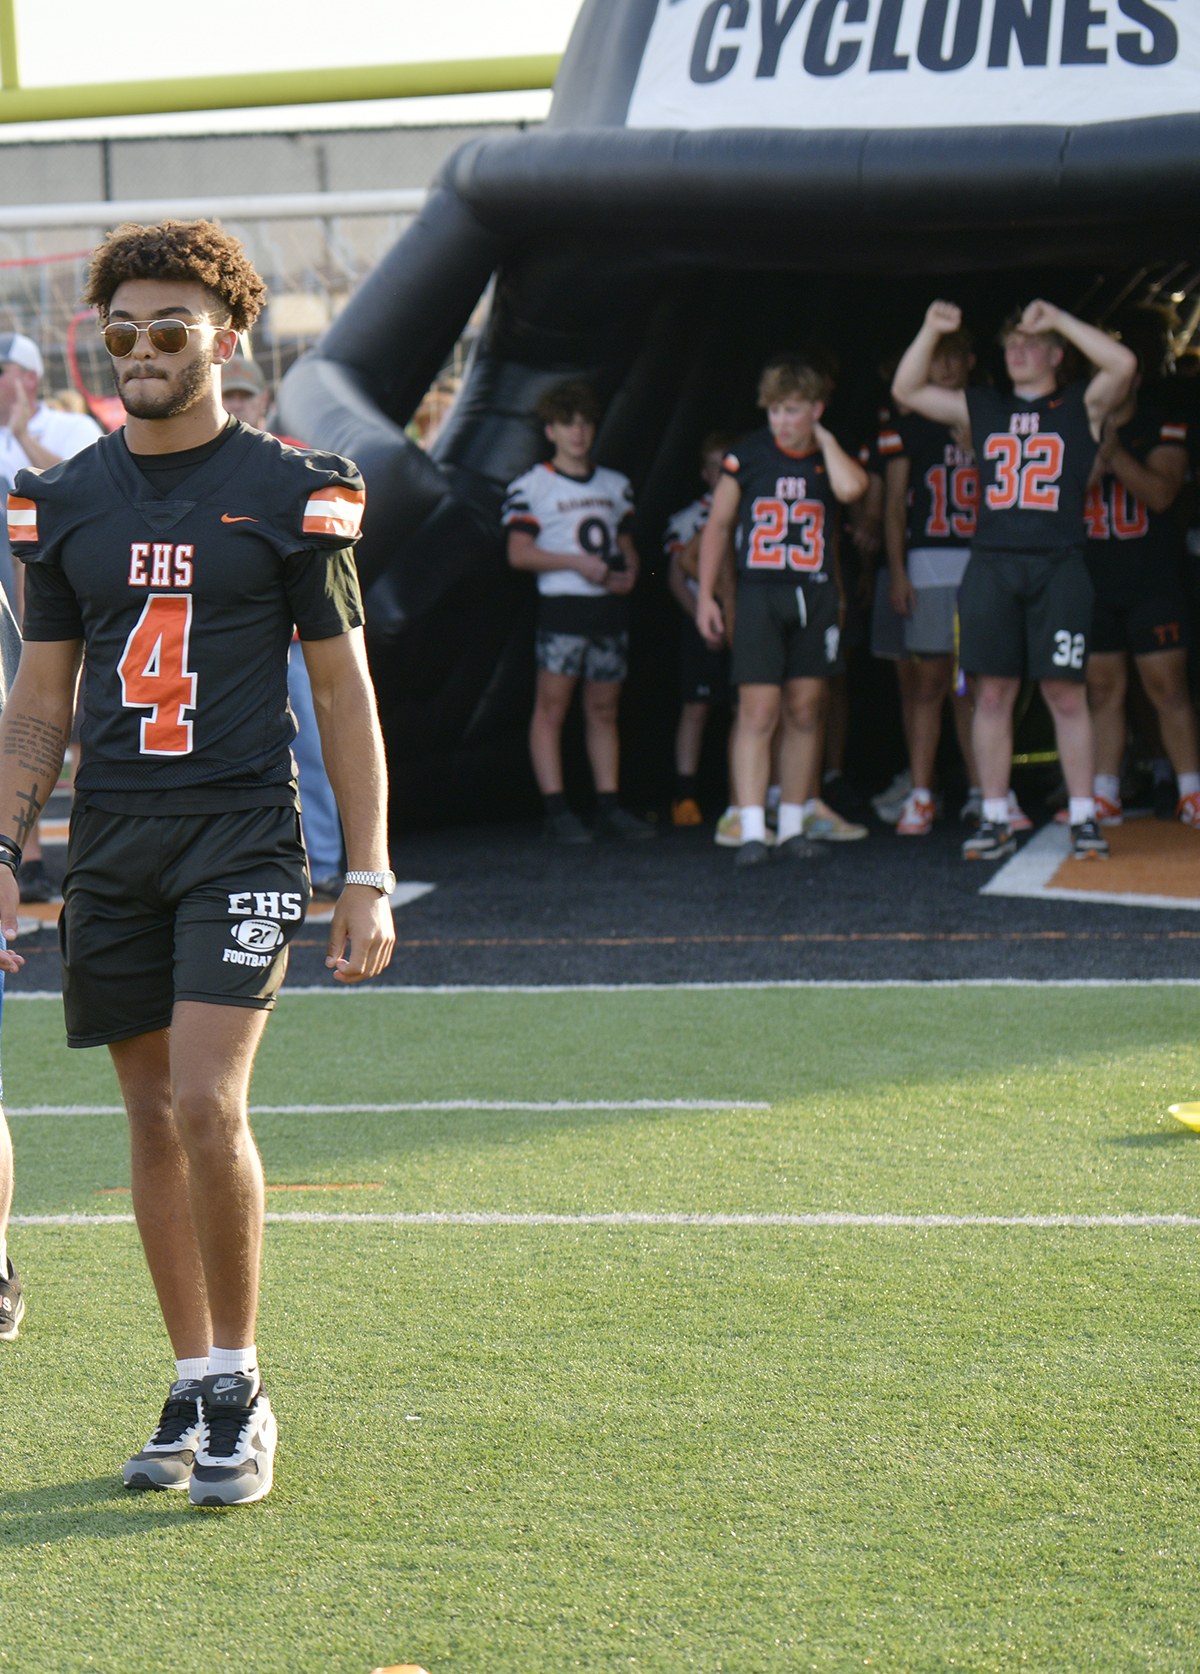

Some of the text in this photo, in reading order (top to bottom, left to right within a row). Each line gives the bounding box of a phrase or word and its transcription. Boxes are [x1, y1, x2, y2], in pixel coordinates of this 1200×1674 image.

[689, 0, 1179, 84] CYCLONES
[925, 464, 981, 537] 19
[984, 432, 1065, 512] 32
[746, 496, 825, 572] 23
[127, 543, 195, 588] EHS
[116, 592, 199, 756] 4
[1052, 629, 1086, 669] 32
[227, 891, 302, 921] EHS
[247, 927, 272, 945] 21
[216, 1377, 239, 1388] NIKE
